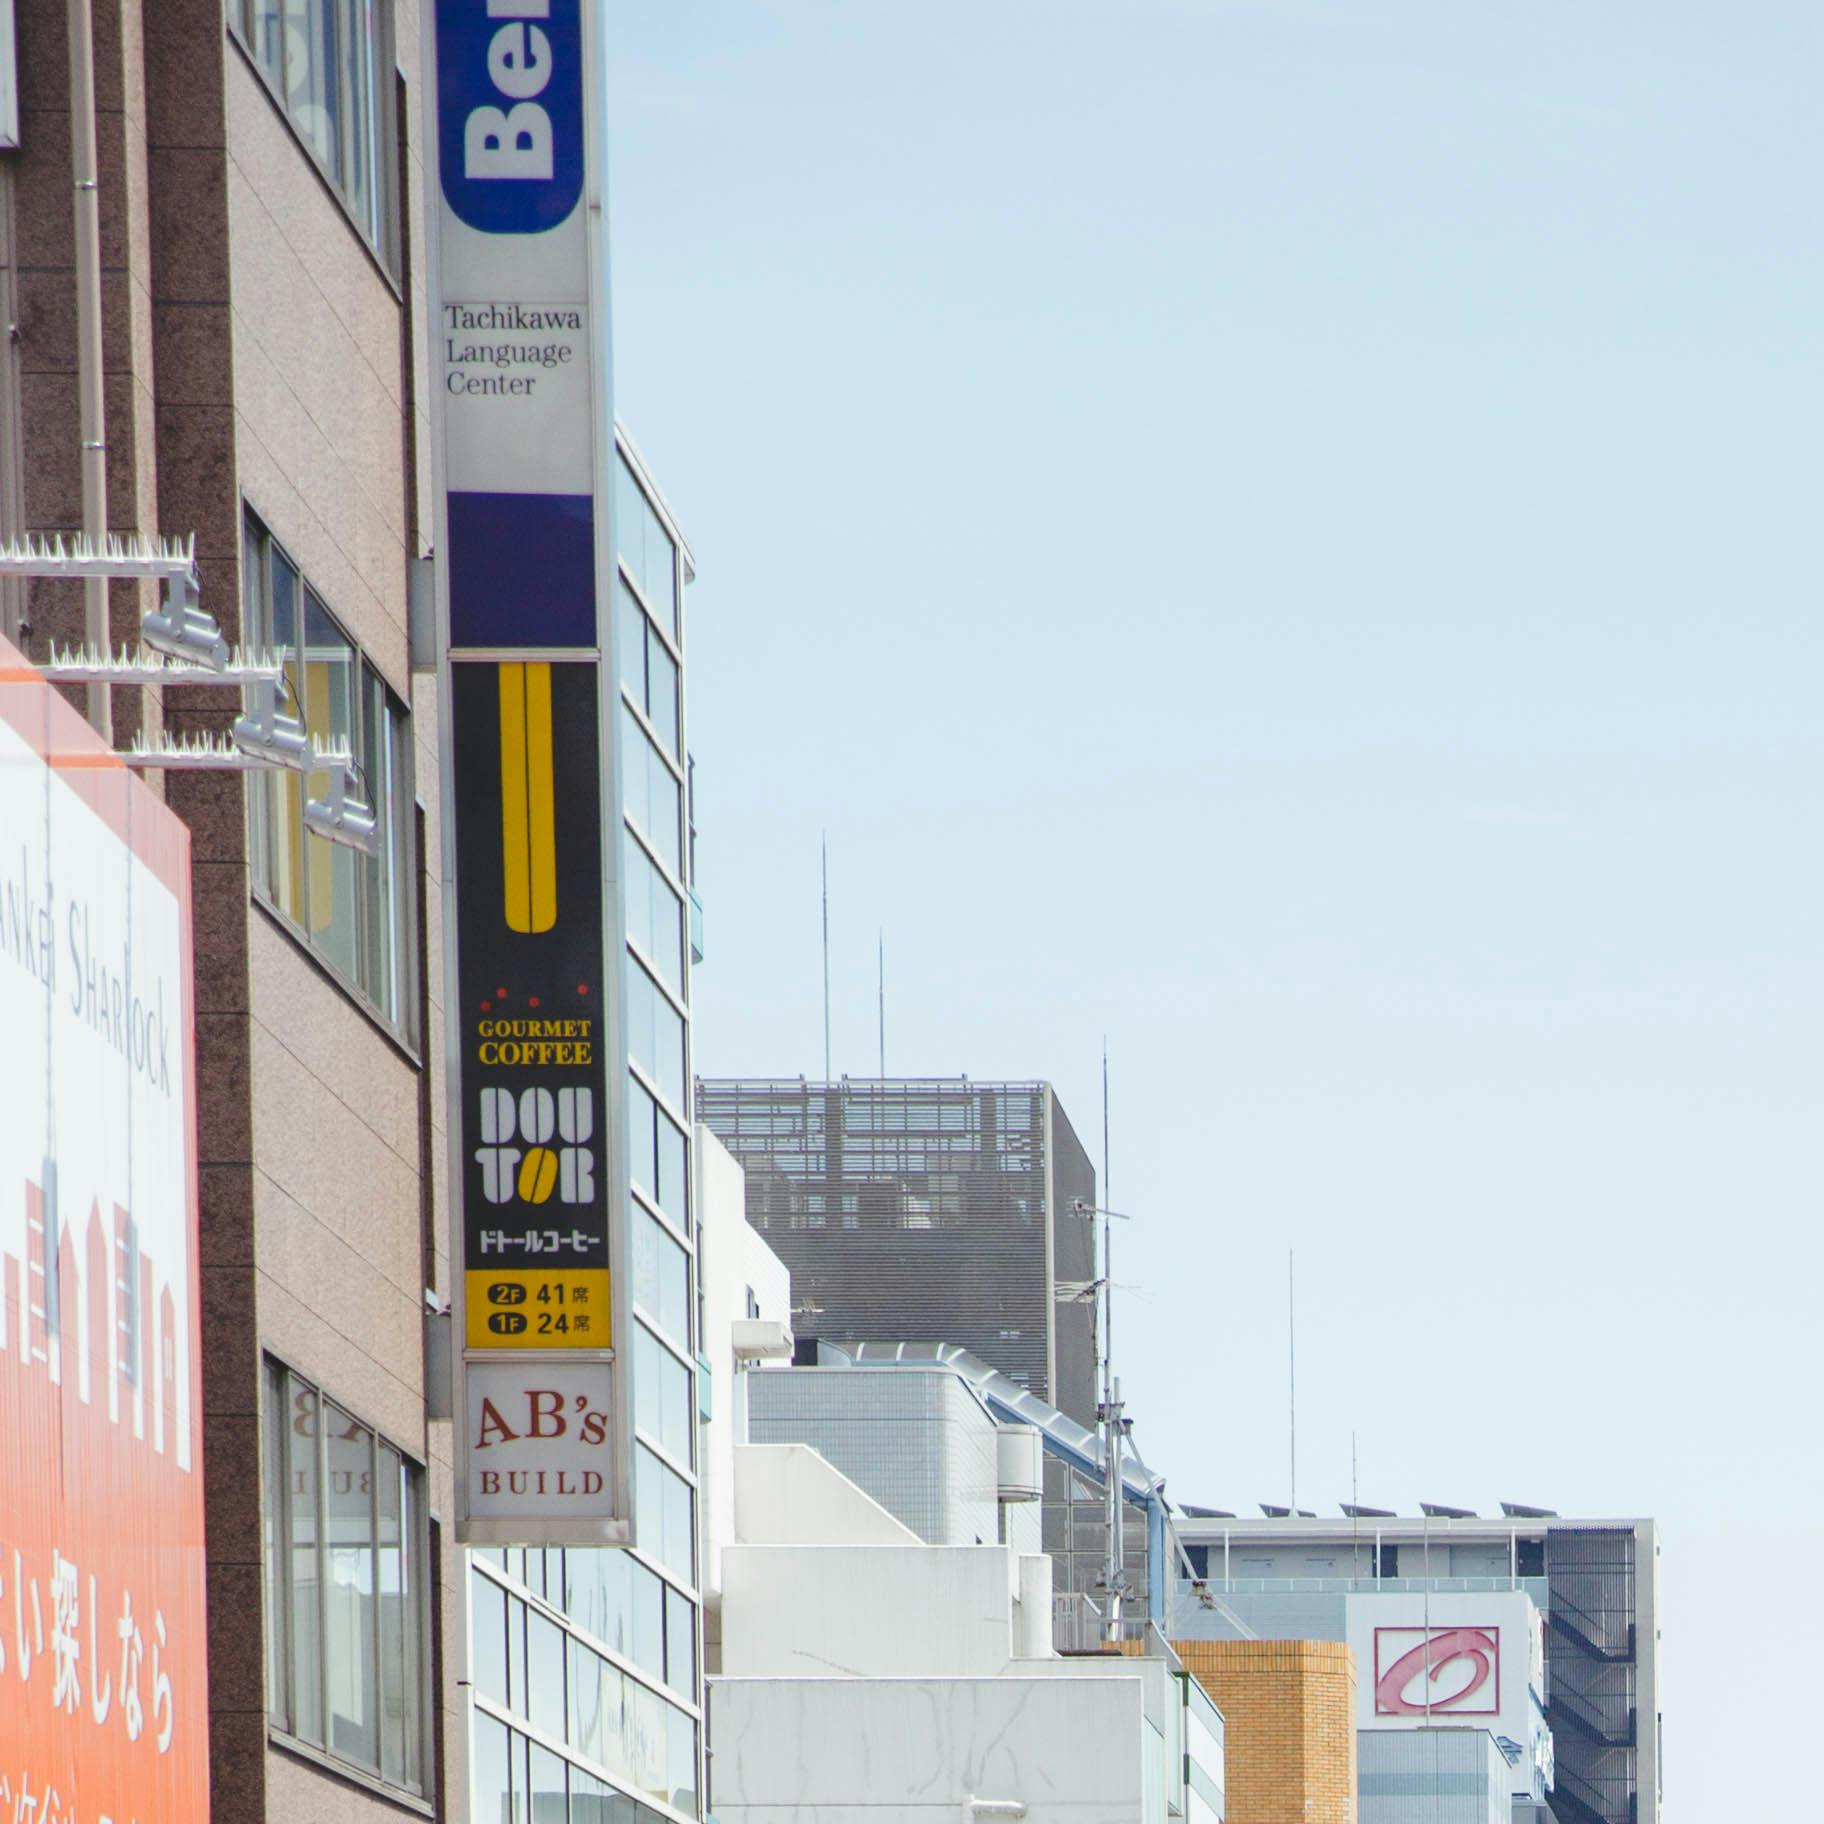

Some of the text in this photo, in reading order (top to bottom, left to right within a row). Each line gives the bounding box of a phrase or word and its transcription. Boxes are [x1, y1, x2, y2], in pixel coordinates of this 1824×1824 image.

[446, 305, 582, 331] Tachikawa
[446, 339, 573, 368] Language
[446, 372, 537, 397] Center
[478, 1019, 592, 1038] GOURMET
[477, 1041, 592, 1067] COFFEE
[479, 1086, 594, 1145] DOU
[479, 1230, 601, 1254] ドトールコーヒー
[495, 1284, 522, 1306] 2F
[496, 1313, 522, 1335] 1F
[474, 1388, 608, 1449] AB's
[480, 1470, 606, 1496] BUILD
